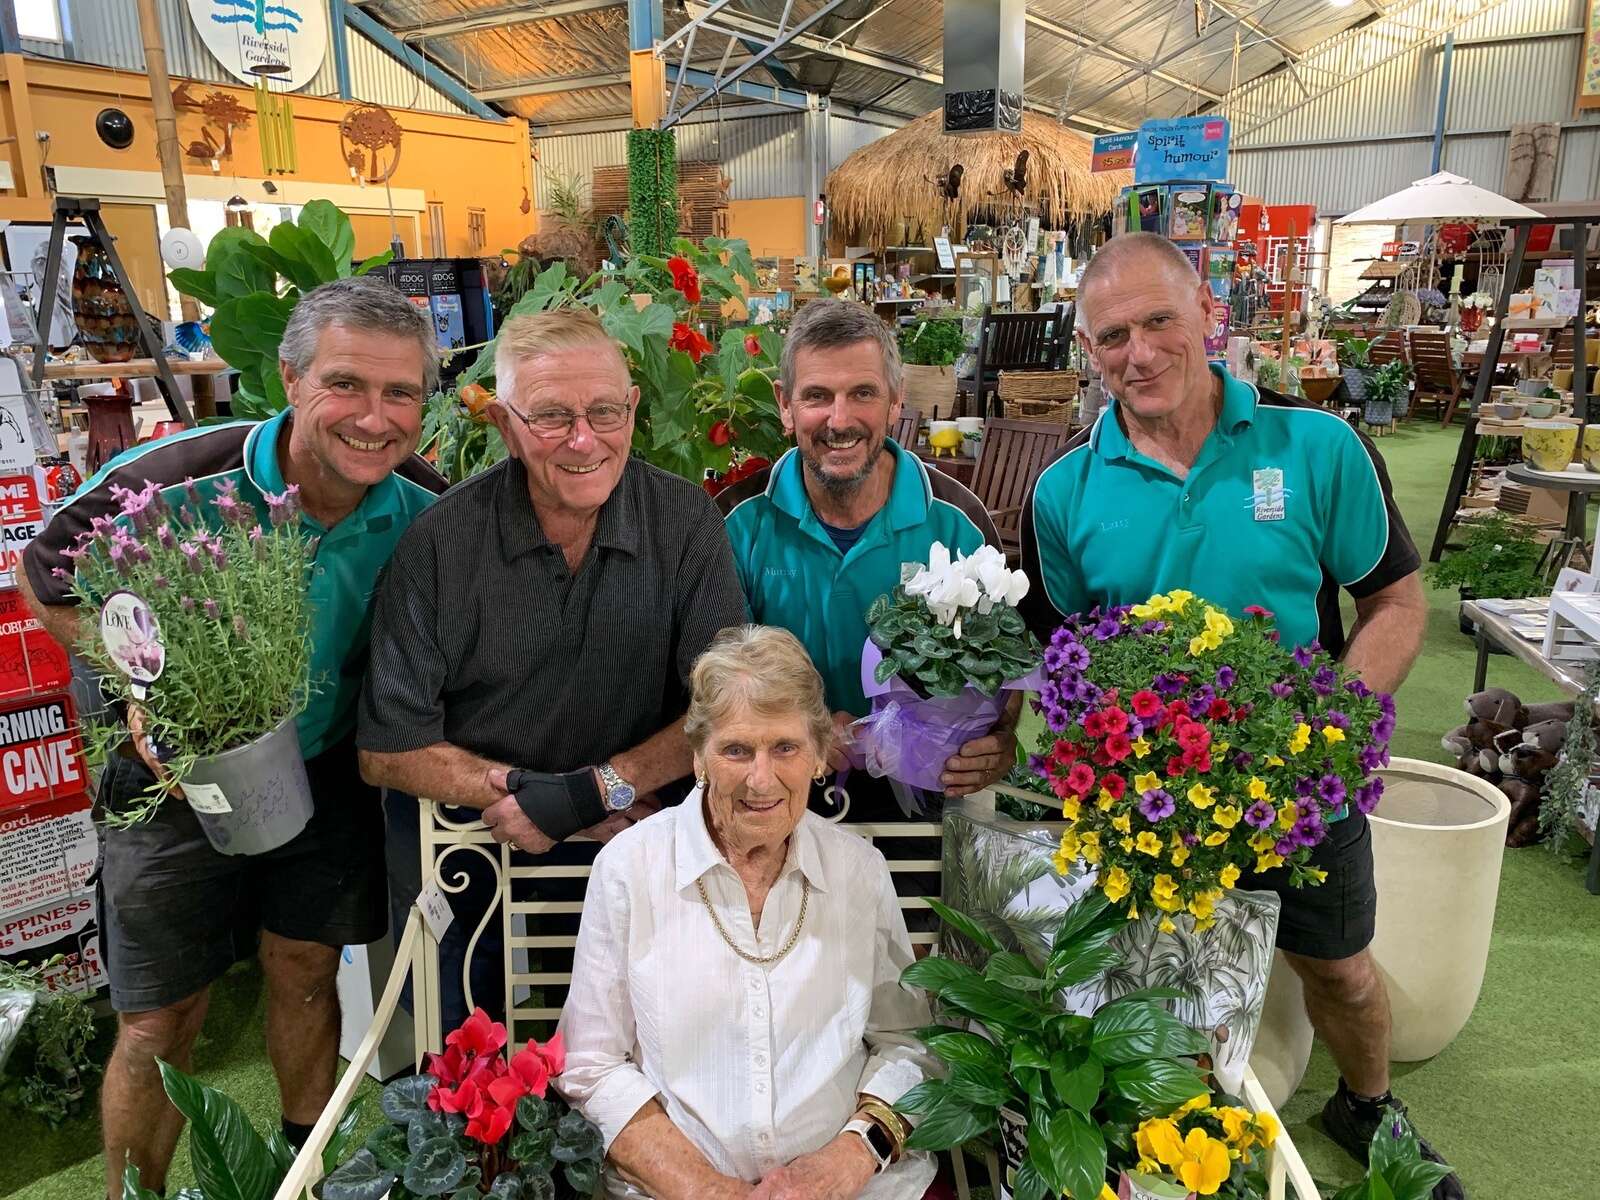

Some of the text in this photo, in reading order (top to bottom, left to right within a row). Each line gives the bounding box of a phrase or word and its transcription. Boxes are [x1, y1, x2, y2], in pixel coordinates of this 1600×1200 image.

[242, 34, 288, 55] Riverside
[245, 50, 286, 66] Gardens
[1147, 134, 1185, 151] spirit
[1163, 150, 1218, 164] humour
[0, 503, 26, 520] LE
[3, 739, 80, 795] CAVE
[16, 826, 39, 838] doing
[21, 919, 72, 941] being
